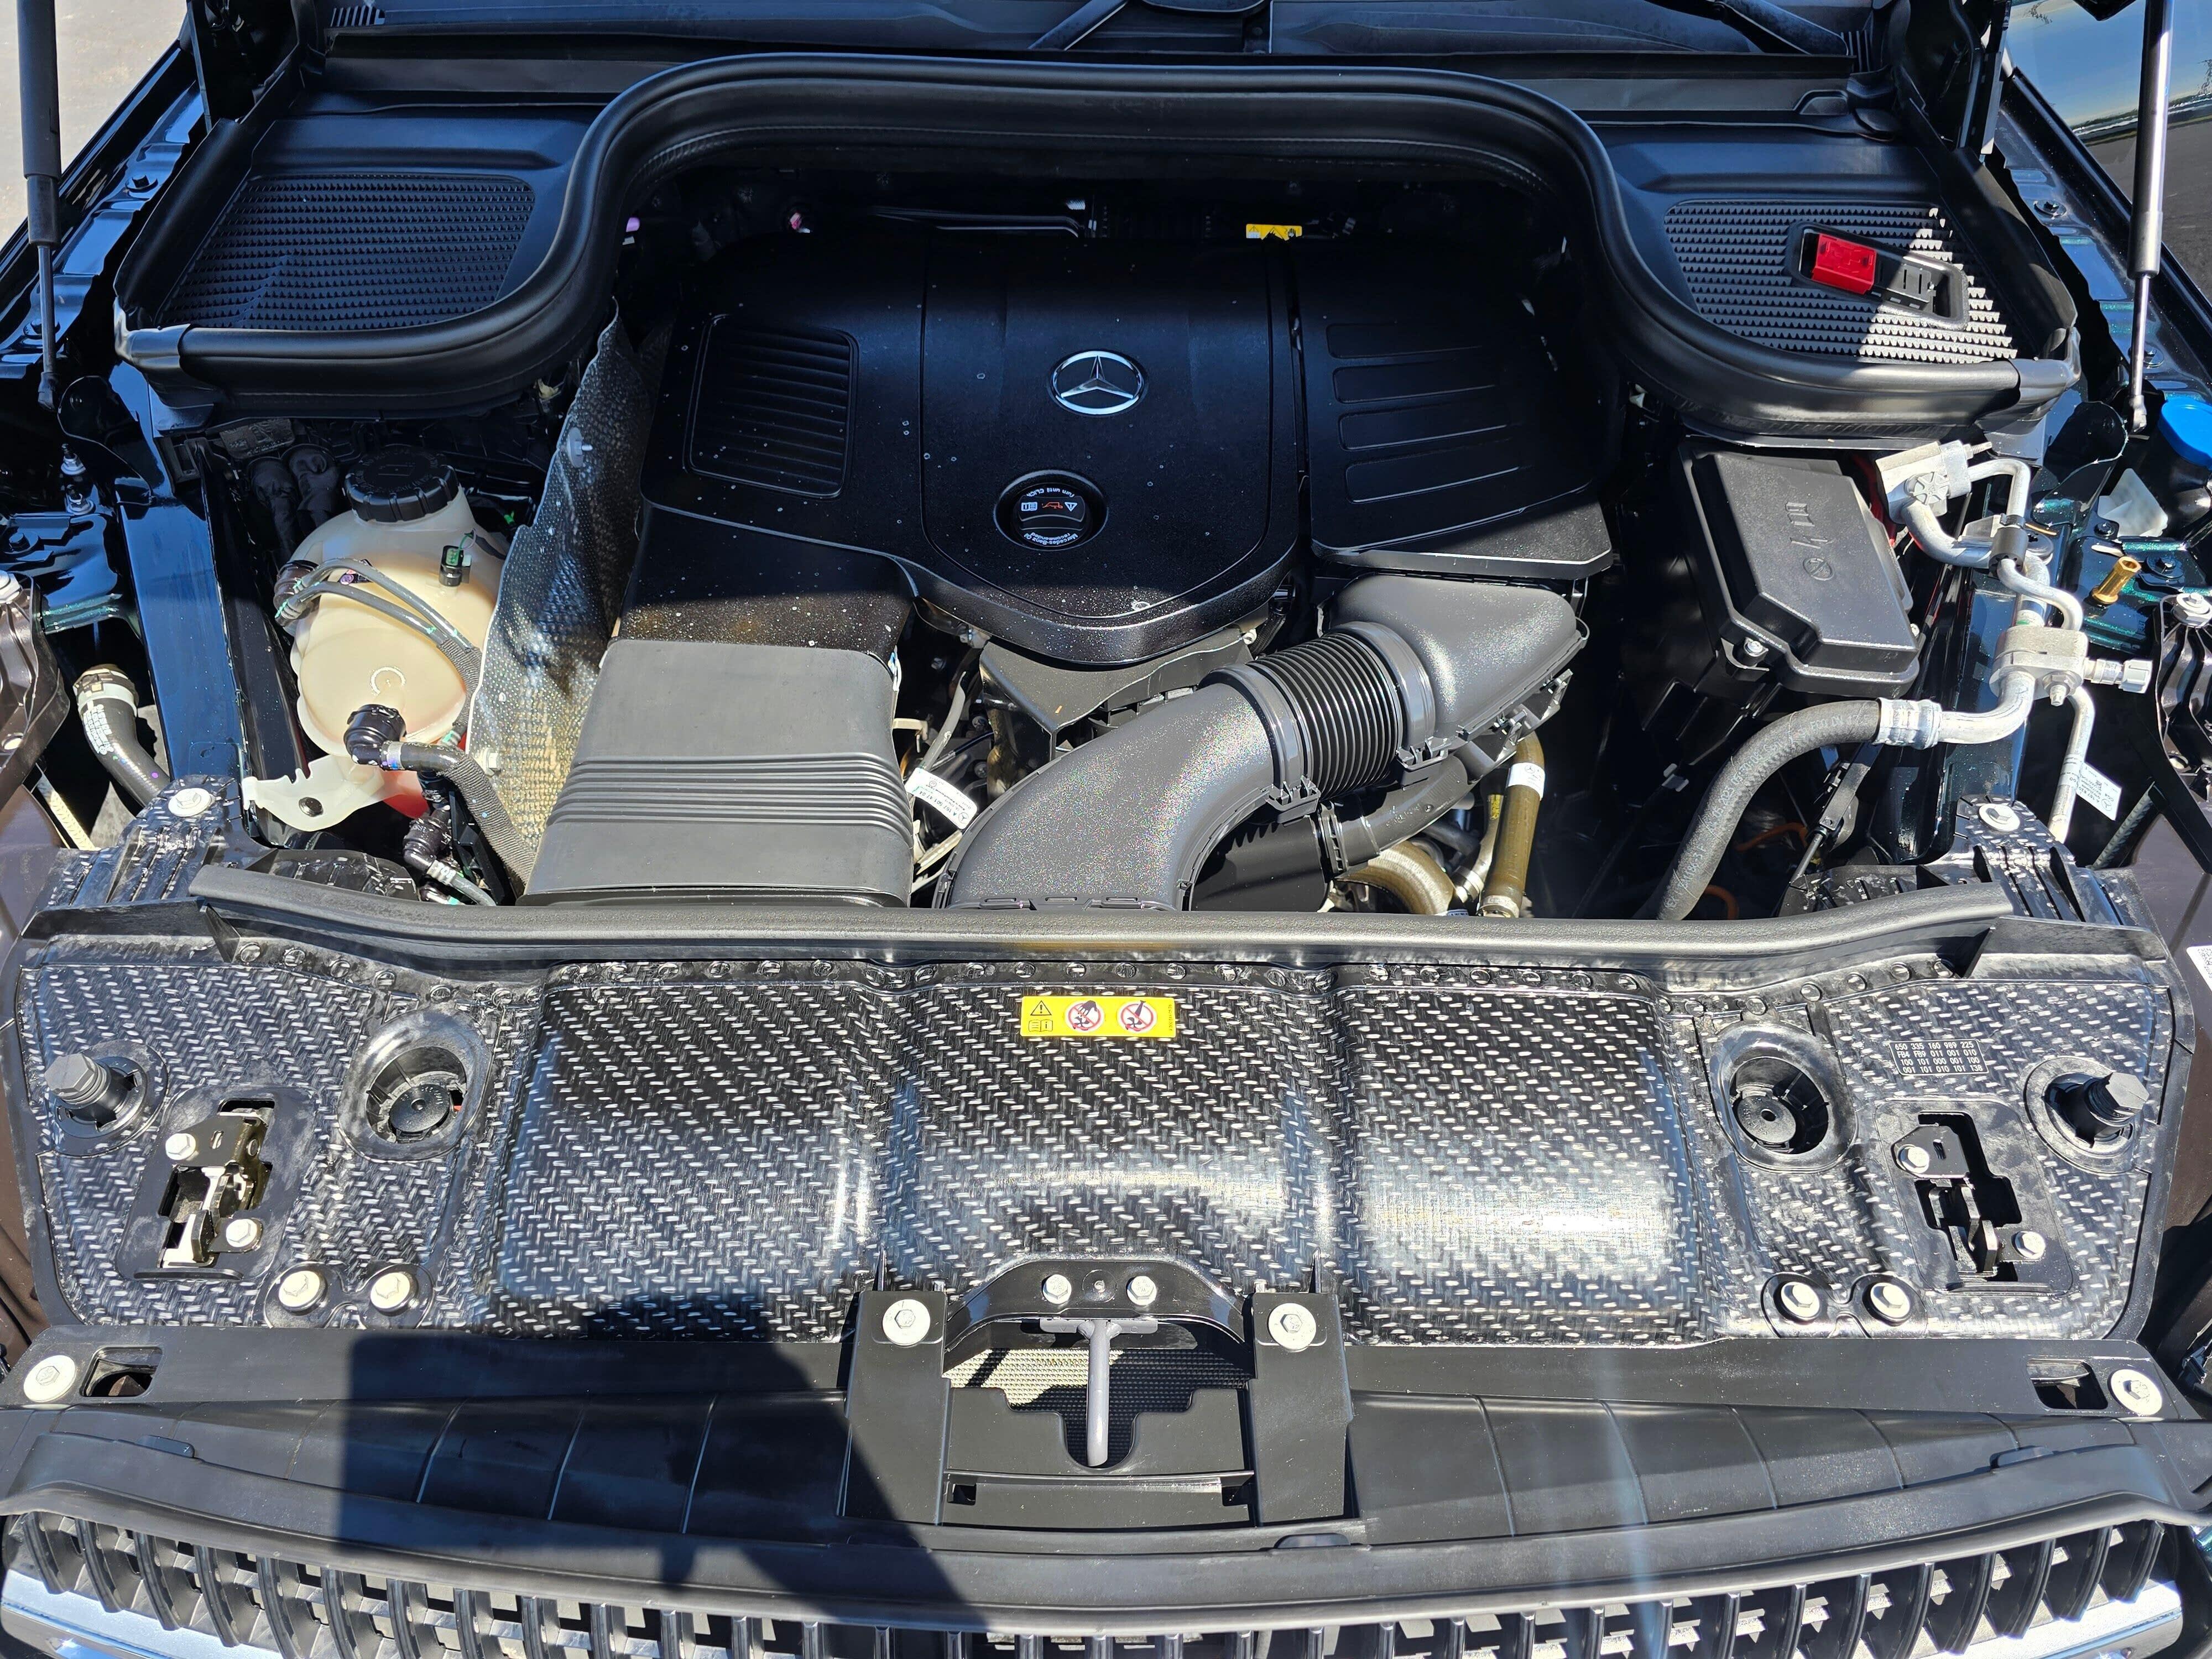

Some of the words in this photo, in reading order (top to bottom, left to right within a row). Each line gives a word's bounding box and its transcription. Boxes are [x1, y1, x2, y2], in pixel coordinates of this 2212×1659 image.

[1026, 488, 1045, 497] CLICK
[1062, 489, 1075, 498] Turn
[1030, 532, 1071, 541] recommended
[1032, 533, 1078, 545] Mercedes-Benz
